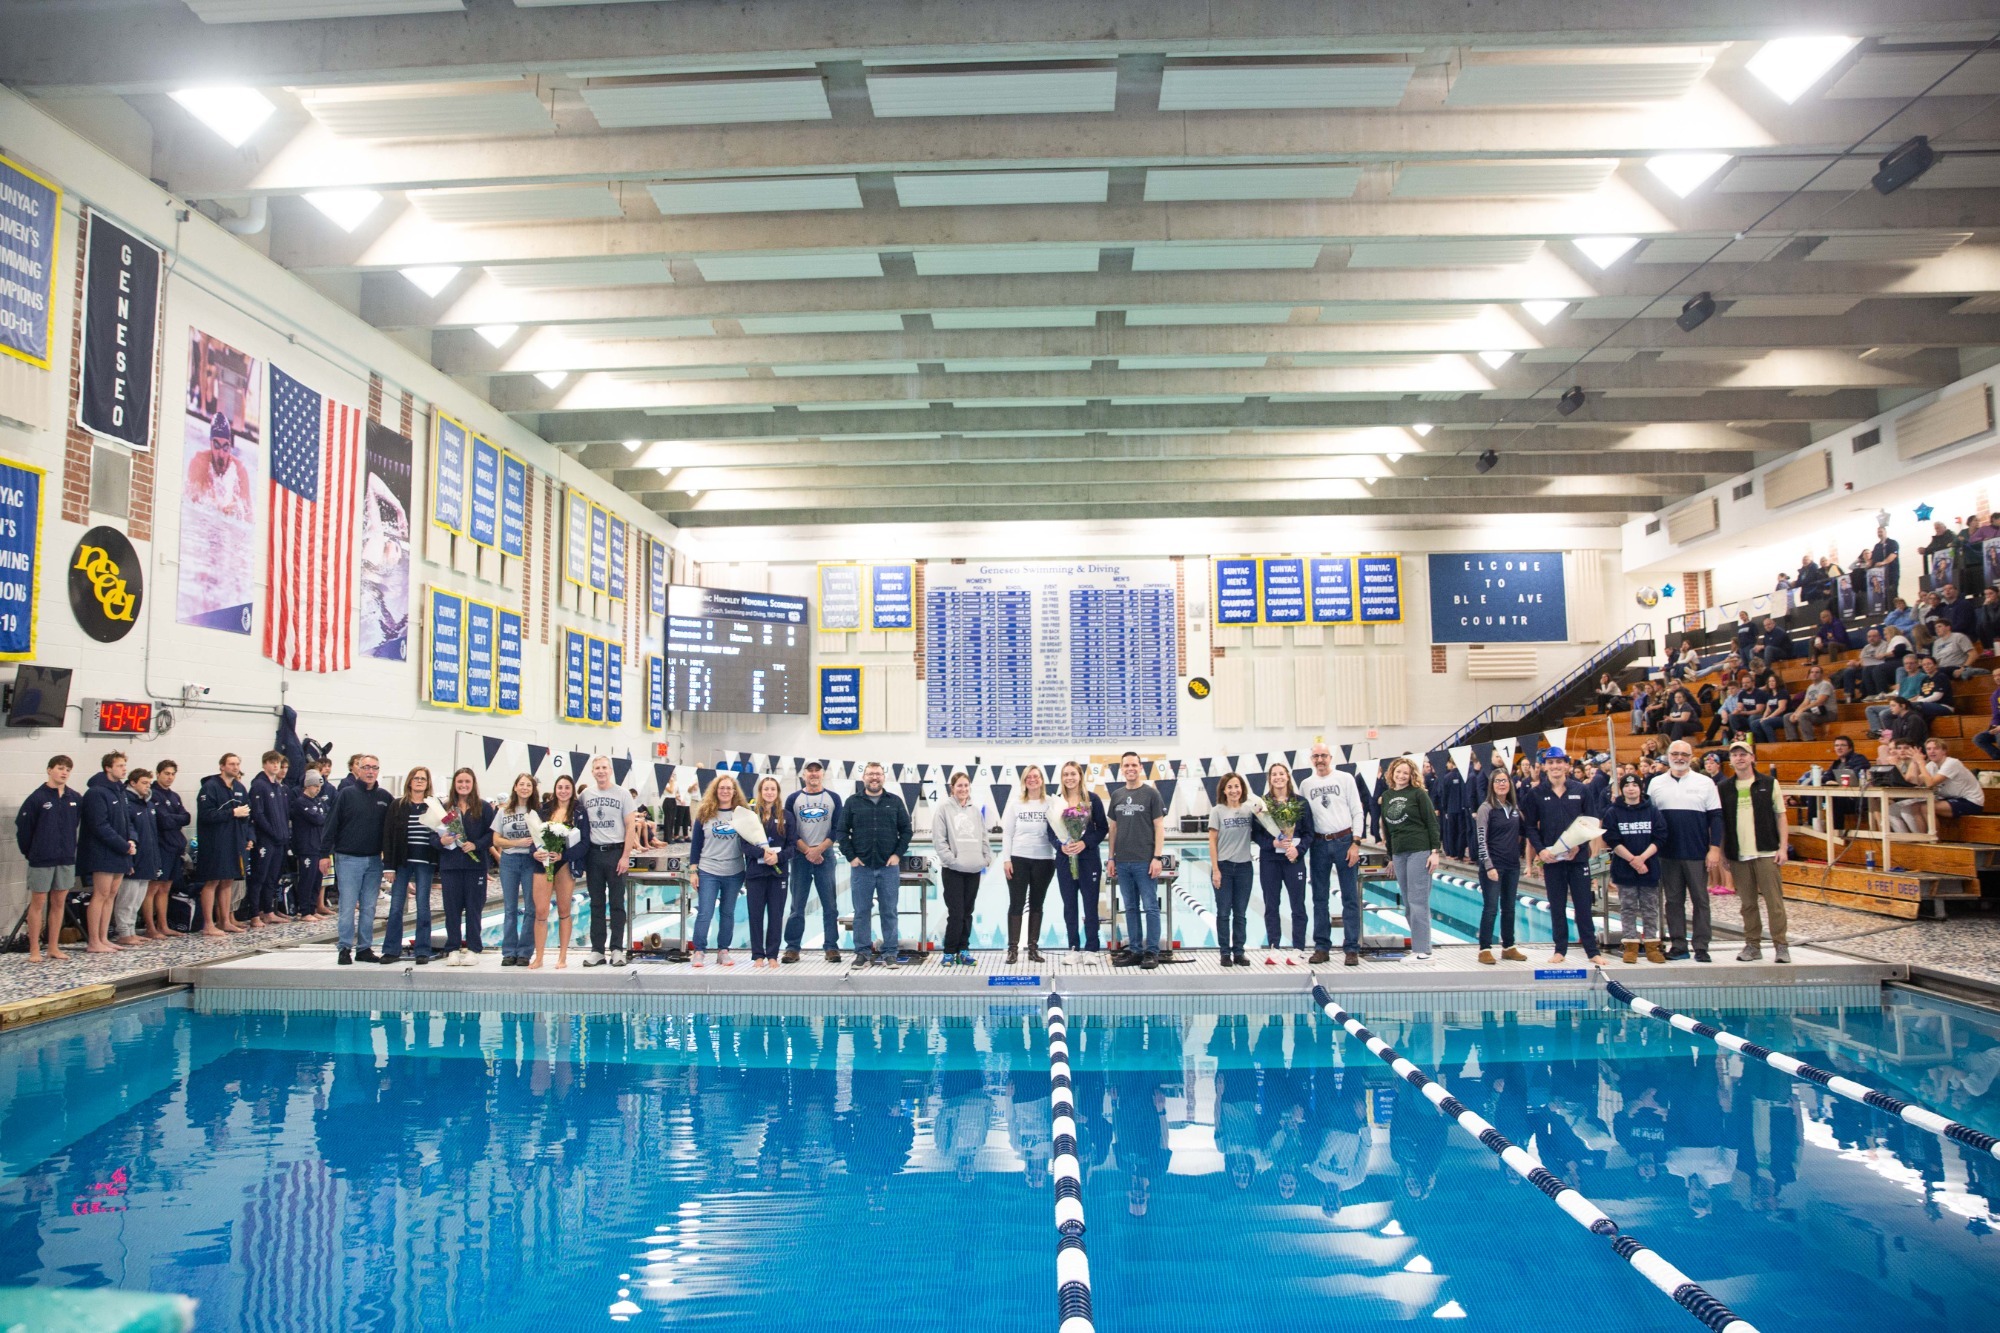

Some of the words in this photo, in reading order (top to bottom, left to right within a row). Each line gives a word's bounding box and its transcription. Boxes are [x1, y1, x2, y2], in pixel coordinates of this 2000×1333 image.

[0, 183, 39, 217] UNYAC
[0, 214, 39, 248] MEN'S
[0, 278, 43, 311] MPIONS
[0, 310, 33, 338] 00-01
[112, 244, 132, 427] GENESEO
[0, 486, 23, 508] YAC
[0, 551, 29, 572] MING
[980, 565, 1020, 574] Geneseo
[1023, 565, 1073, 575] Swimming
[1077, 565, 1085, 574] &
[1089, 564, 1120, 575] Diving
[1223, 567, 1249, 575] SUNYAC
[1270, 565, 1296, 573] SUNYAC
[1319, 564, 1343, 572] SUNYAC
[1365, 564, 1390, 572] SUNYAC
[74, 544, 136, 622] ncaa
[1226, 577, 1247, 585] MEN'S
[1269, 576, 1298, 584] WOMEN'S
[1320, 575, 1342, 583] MEN'S
[1485, 579, 1505, 588] TO
[1362, 596, 1397, 604] CHAMPIONS
[829, 674, 852, 682] SUNYAC
[825, 695, 856, 703] SWIMMING
[823, 706, 857, 714] CHAMPIONS
[101, 703, 149, 732] 43:42
[1503, 745, 1510, 758] 1
[554, 755, 562, 767] 6
[928, 790, 938, 802] 4
[1309, 785, 1340, 800] GENESEO
[585, 796, 621, 809] GENESEO
[502, 813, 524, 824] GENE
[1018, 811, 1047, 820] GENESE
[629, 858, 636, 868] 5
[1361, 855, 1368, 865] 2
[1898, 883, 1919, 895] DEEP
